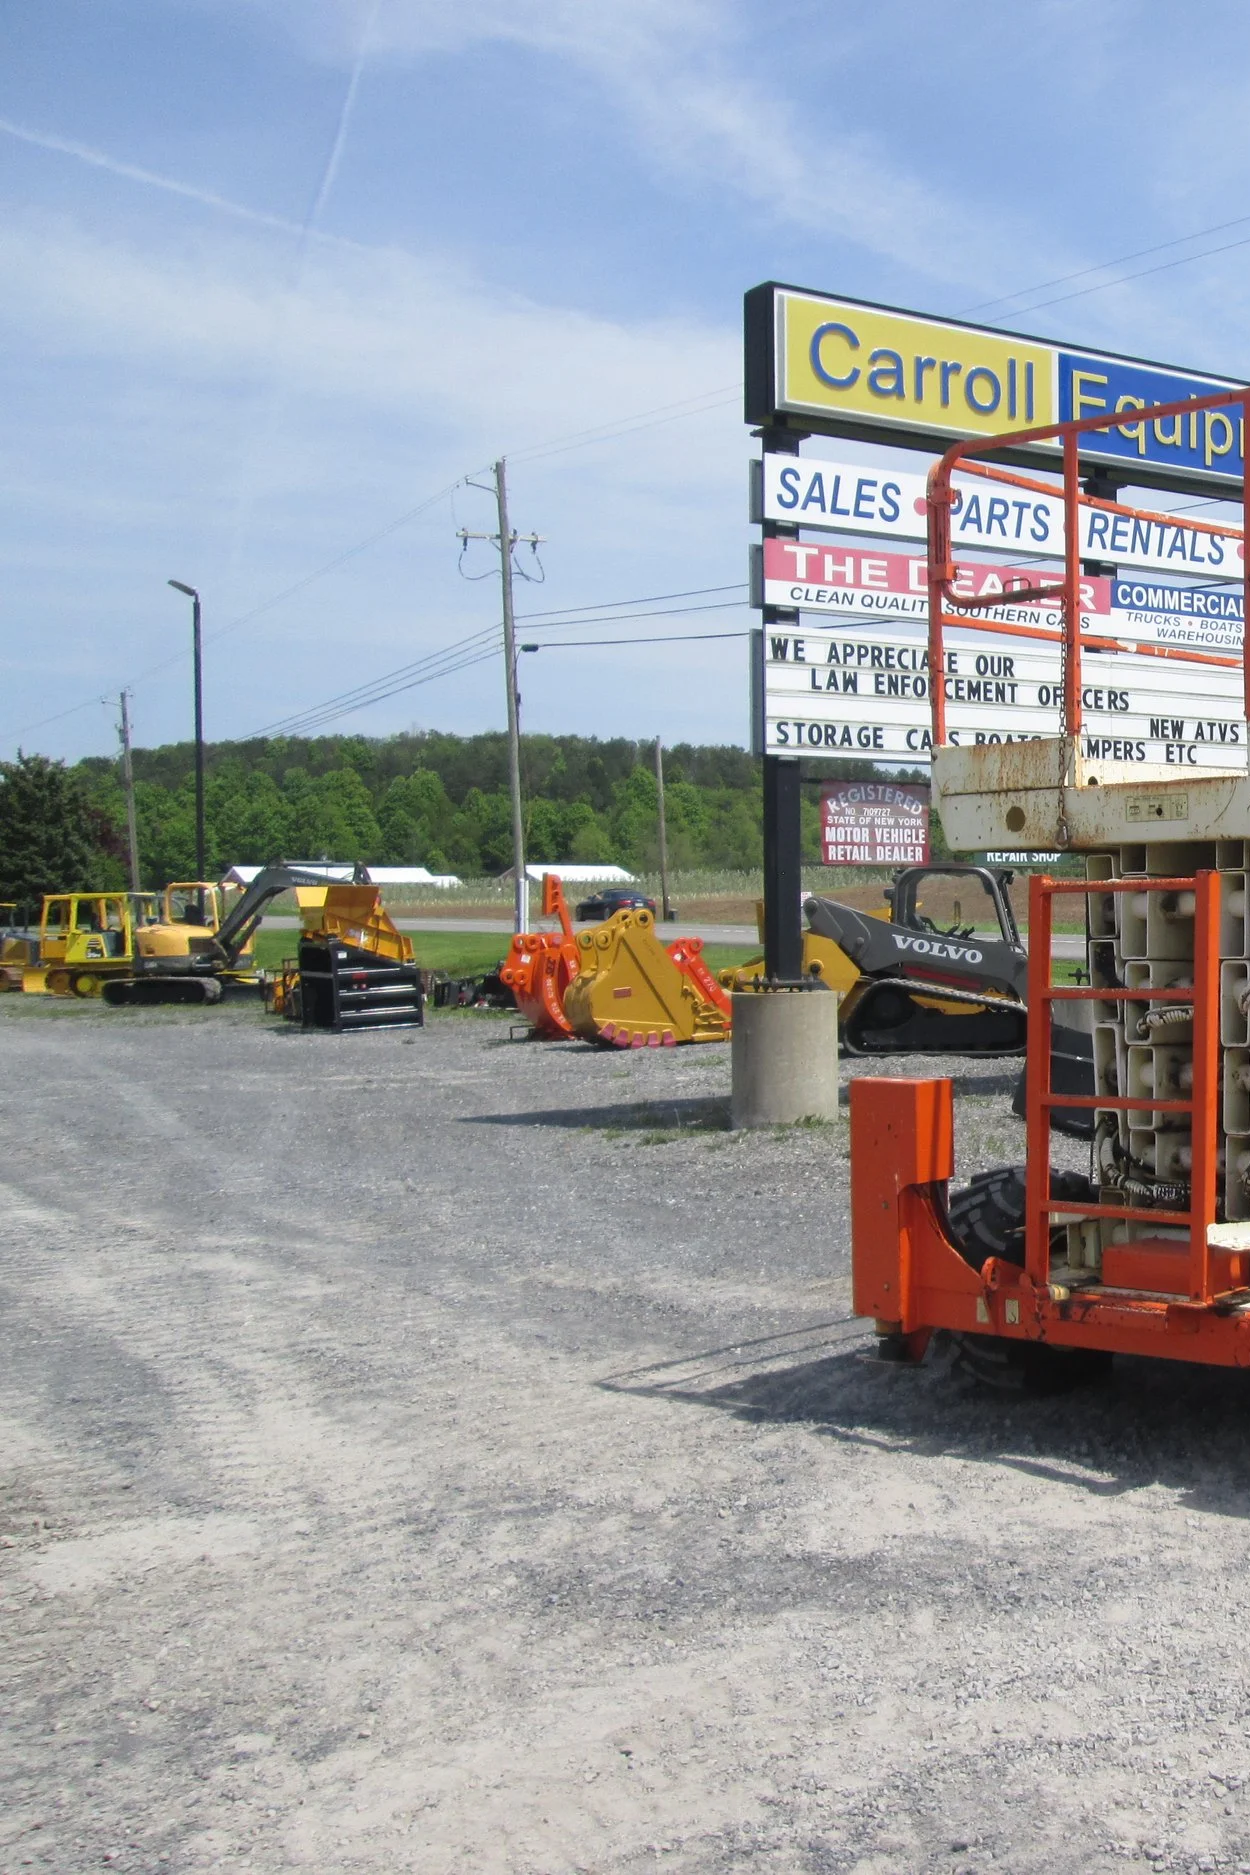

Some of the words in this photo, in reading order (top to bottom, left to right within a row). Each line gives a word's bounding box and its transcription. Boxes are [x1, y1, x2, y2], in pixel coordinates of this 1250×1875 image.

[810, 321, 1034, 422] Carroll
[776, 467, 901, 522] SALES
[1087, 512, 1226, 565] RENTALS
[783, 545, 889, 588] THE
[790, 587, 855, 607] CLEAN
[860, 594, 930, 613] QUALIT
[944, 602, 1041, 624] SOUTHERN
[1046, 613, 1091, 629] CAS
[1126, 611, 1181, 627] TRUCKS
[1199, 620, 1242, 634] BOATS
[1156, 627, 1245, 646] WAREHOUSIN
[771, 637, 806, 662] WE
[975, 654, 1015, 678] OUR
[811, 668, 858, 694] LAW
[874, 673, 1018, 704] ENFOCEMENT
[1038, 684, 1130, 711] OFCERS
[776, 720, 884, 749] STORAGE
[905, 728, 959, 751] CAS
[1081, 738, 1146, 762] MPERS
[1165, 743, 1198, 764] ETC
[1150, 718, 1185, 740] NEW
[1194, 721, 1240, 744] ATVS
[827, 785, 922, 815] REGISTERED
[825, 826, 870, 843] MOTOR
[874, 827, 926, 844] VEHICLE
[827, 815, 856, 825] STATE
[859, 816, 872, 825] OF
[874, 817, 895, 826] NEW
[897, 817, 923, 826] YORK
[828, 844, 872, 861] RETAIL
[876, 845, 923, 862] DEALER
[892, 934, 983, 964] VOLVO
